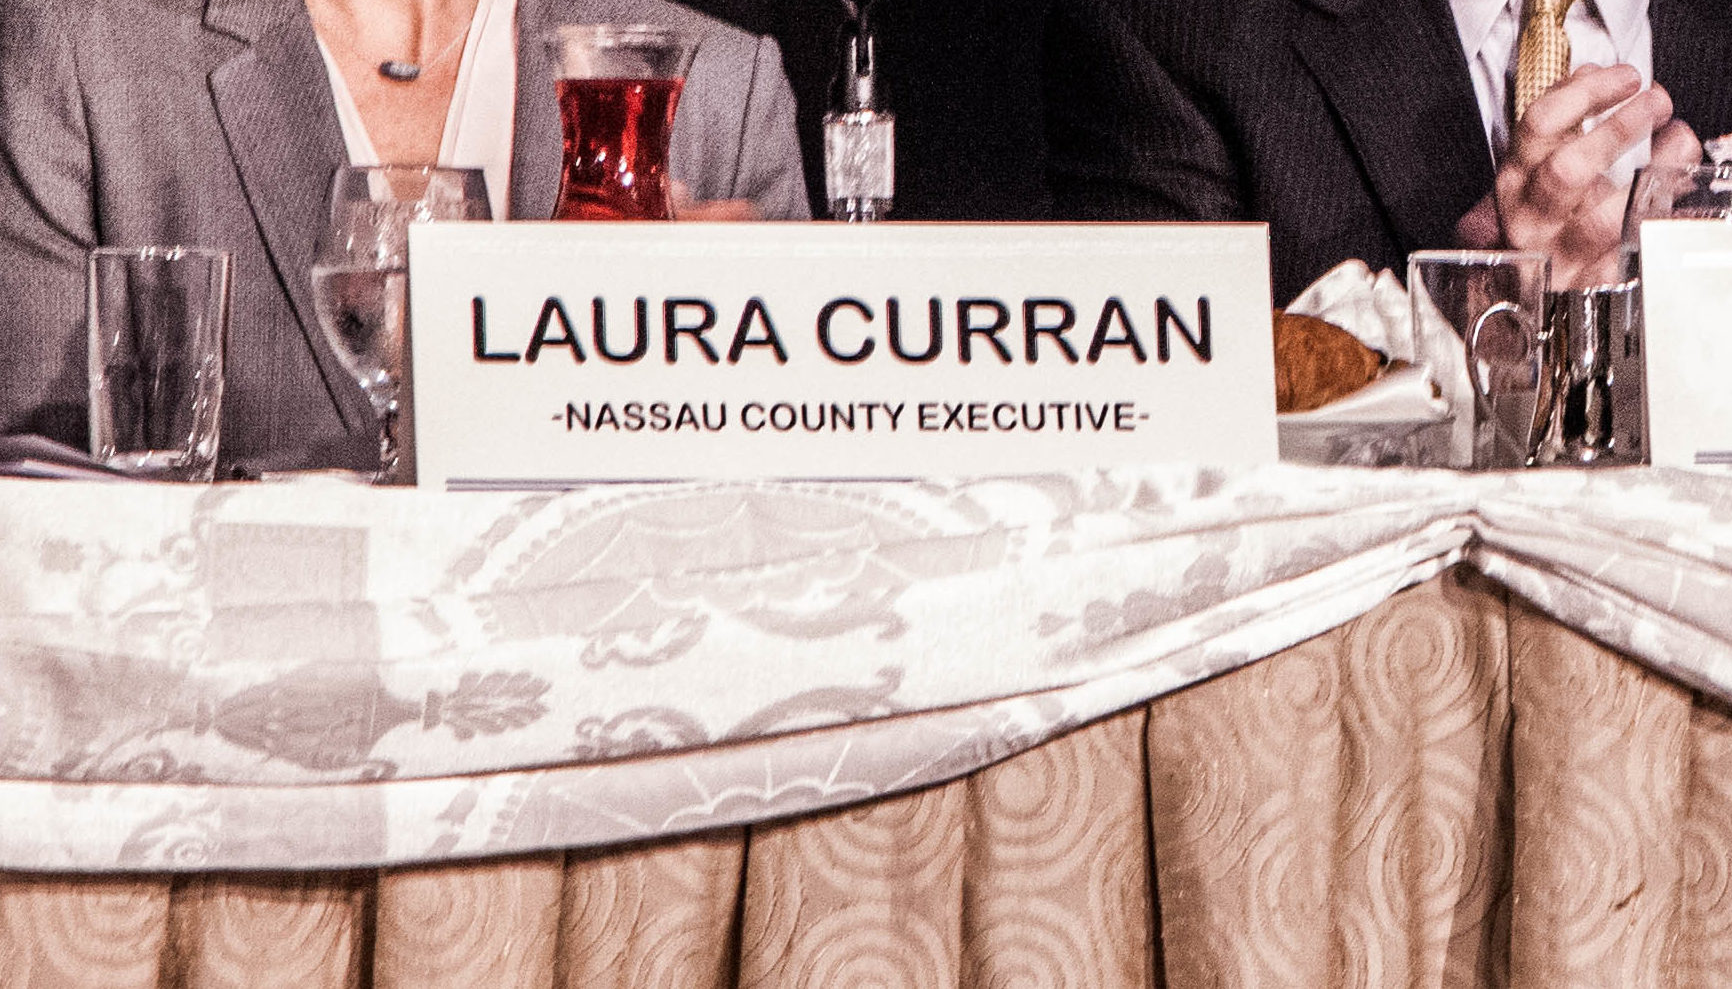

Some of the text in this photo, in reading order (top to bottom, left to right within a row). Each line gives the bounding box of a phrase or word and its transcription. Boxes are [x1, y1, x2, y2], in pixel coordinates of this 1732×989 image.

[471, 295, 1213, 366] LAURA CURRAN
[551, 401, 1150, 433] -NASSAU COUNTY EXECUTIVE-
